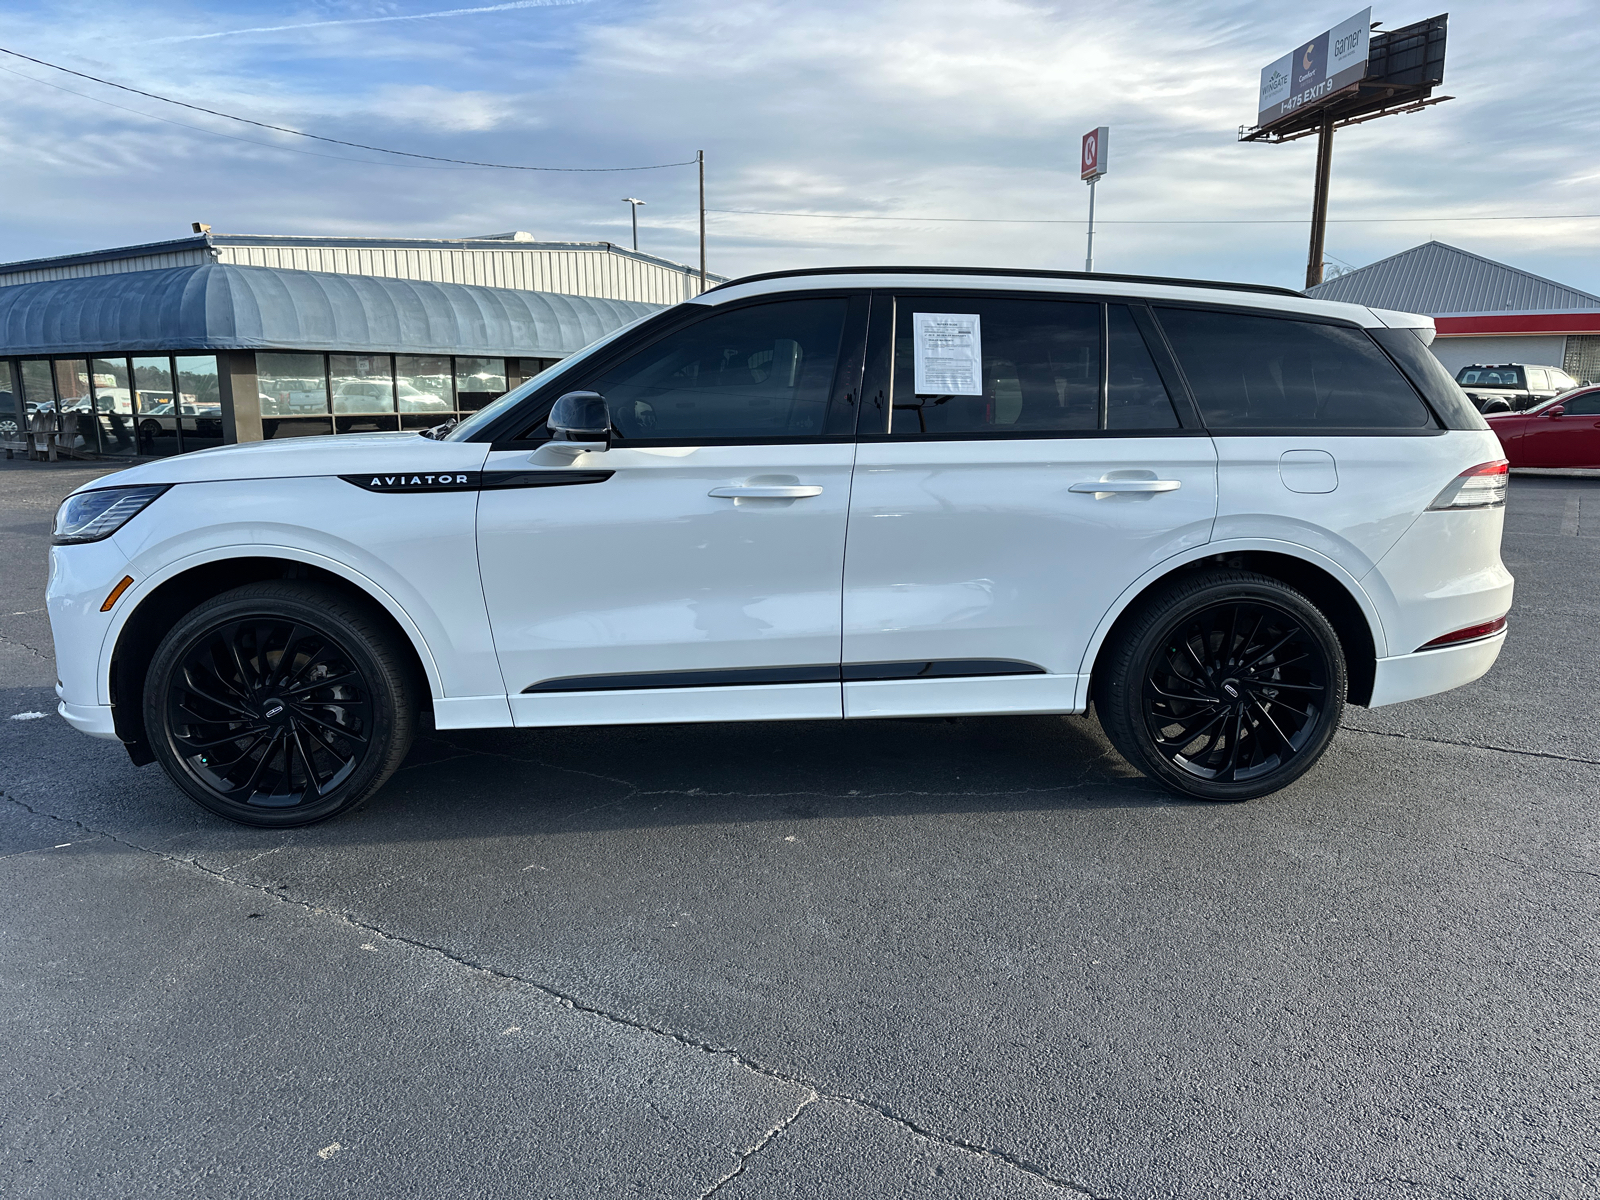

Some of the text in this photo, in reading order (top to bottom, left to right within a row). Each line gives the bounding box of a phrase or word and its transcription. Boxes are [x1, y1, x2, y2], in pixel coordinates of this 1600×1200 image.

[1335, 29, 1361, 57] Garner
[1262, 74, 1288, 95] WINGATE
[1298, 69, 1316, 83] Comfort
[1280, 93, 1302, 114] I-475
[1304, 81, 1326, 102] EXIT
[1327, 78, 1333, 91] 9
[370, 474, 468, 486] AVIATOR
